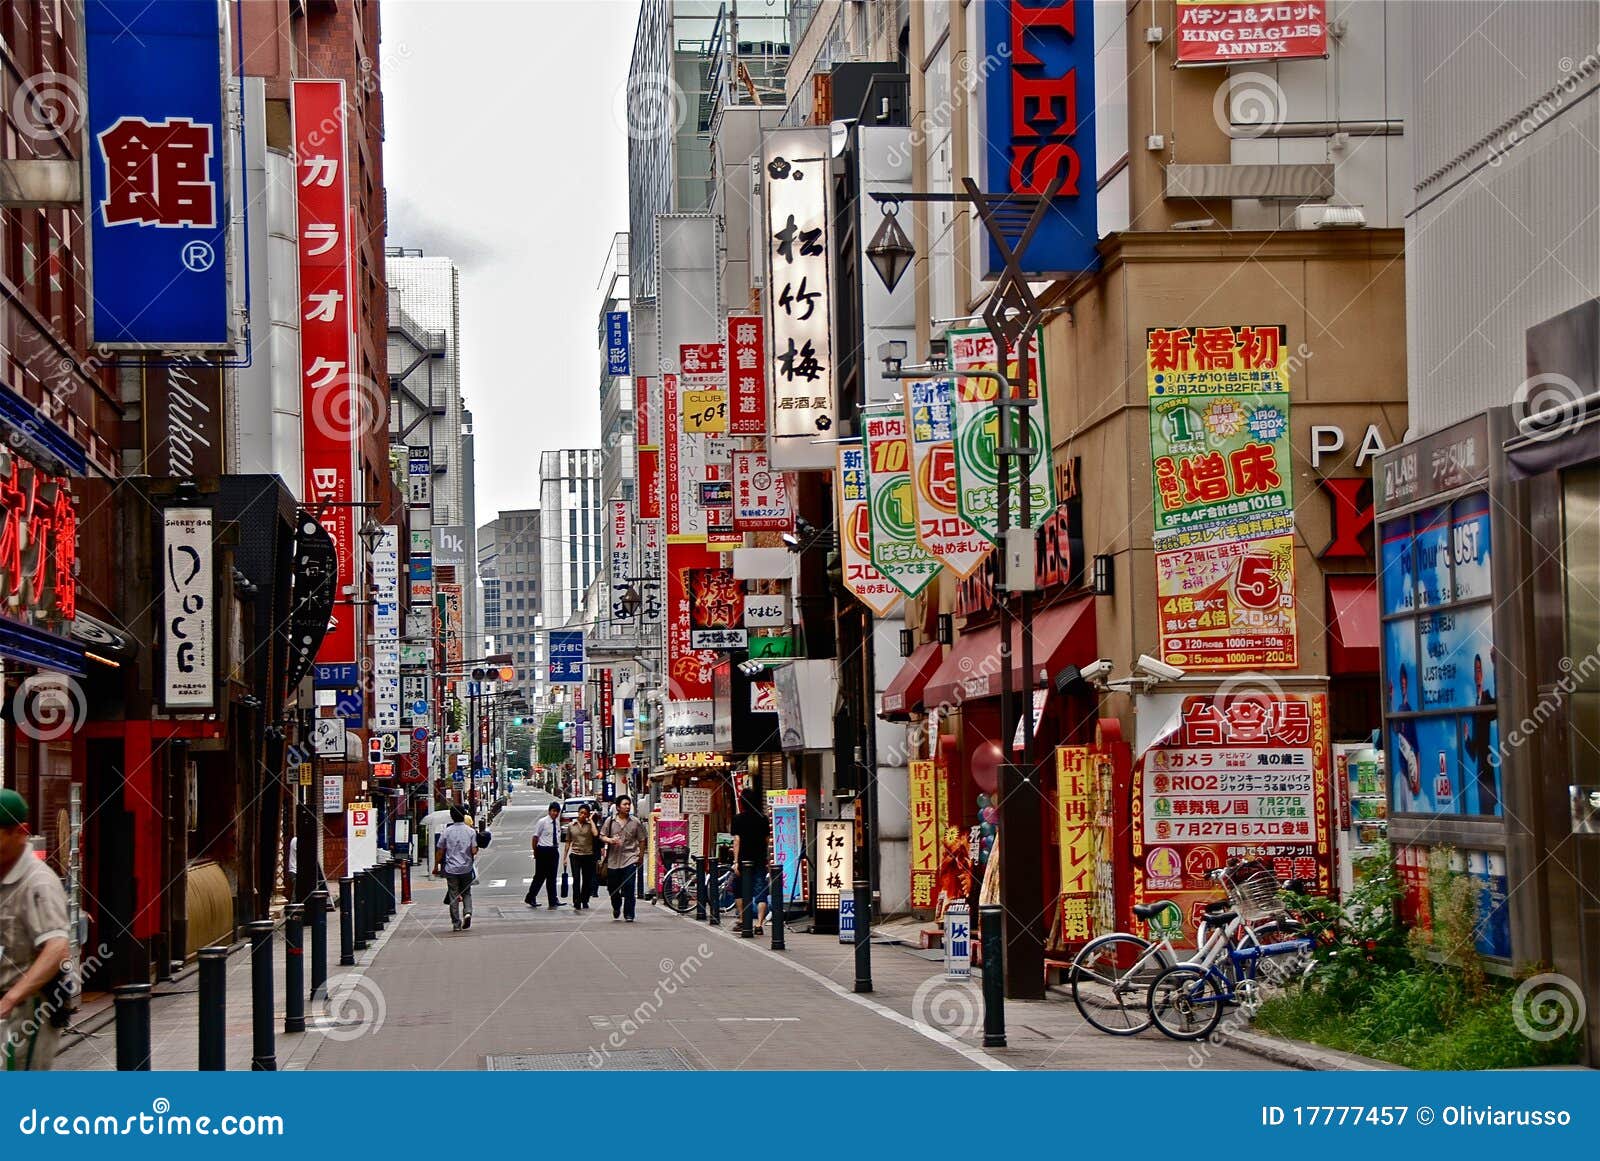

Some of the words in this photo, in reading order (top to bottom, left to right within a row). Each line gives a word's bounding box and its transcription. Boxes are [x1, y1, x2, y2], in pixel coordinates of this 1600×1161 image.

[1182, 4, 1321, 25] パチンコ&スロット
[1182, 29, 1235, 42] KING
[1238, 24, 1322, 40] EAGLES
[1216, 41, 1287, 55] ANNEX
[98, 117, 217, 228] 館
[301, 155, 347, 389] カラオケ
[773, 214, 826, 383] 松竹梅
[736, 323, 758, 370] 麻雀
[1149, 327, 1280, 372] 新橋初
[667, 380, 677, 410] TEL
[778, 397, 828, 410] 居酒屋
[867, 419, 906, 437] 都内
[1310, 424, 1412, 469] PA
[1179, 443, 1281, 504] 増床
[932, 540, 991, 556] 始めました
[883, 563, 938, 575] やってます
[701, 571, 738, 629] 焼肉
[748, 605, 783, 618] やまむら
[320, 667, 352, 680] B1F
[551, 661, 581, 673] 注意
[1153, 702, 1312, 746] 台登場
[1171, 753, 1213, 767] ガメラ
[1171, 775, 1218, 791] RIO2
[1257, 797, 1302, 806] 7月27日
[826, 831, 845, 889] 松竹梅
[1063, 897, 1090, 941] 無料
